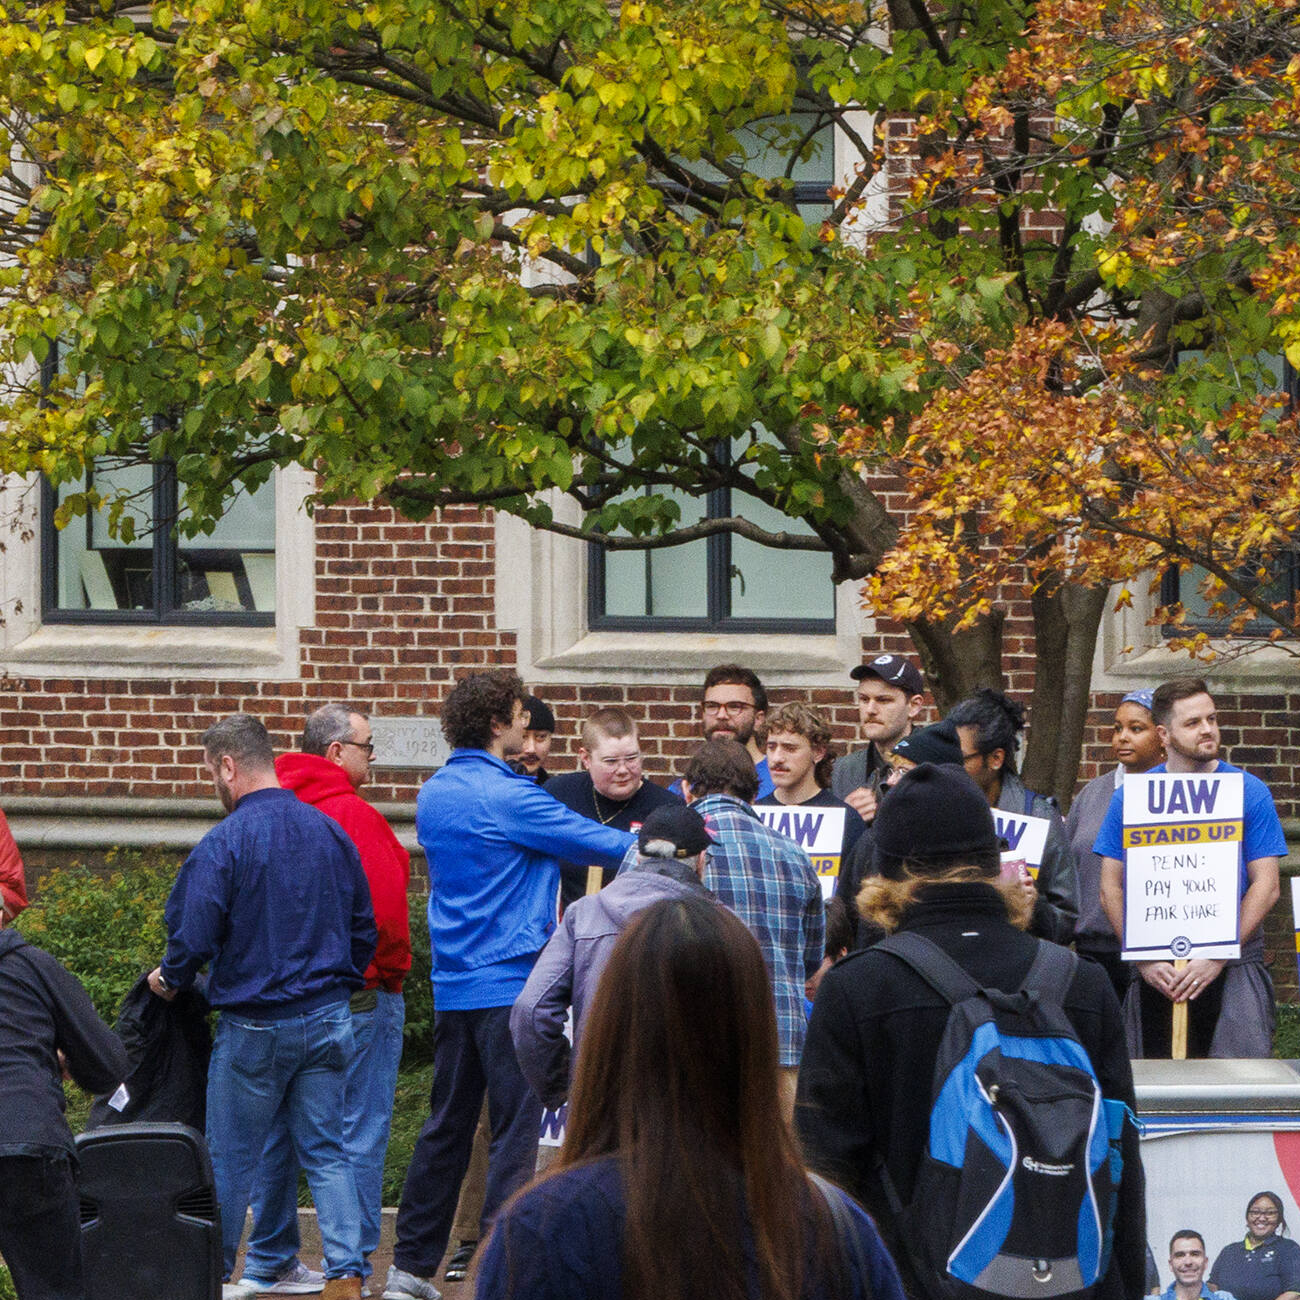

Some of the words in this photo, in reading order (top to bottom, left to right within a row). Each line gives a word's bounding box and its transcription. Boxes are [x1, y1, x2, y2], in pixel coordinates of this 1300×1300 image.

[406, 740, 437, 758] 1928
[1148, 779, 1220, 814] UAW
[1130, 827, 1200, 845] STAND
[1208, 825, 1236, 841] UP
[1152, 854, 1205, 870] PENN:
[1145, 879, 1171, 898] PAY
[1181, 877, 1217, 894] YOUR
[1145, 905, 1177, 922] FAIR
[1183, 903, 1219, 921] SHARE
